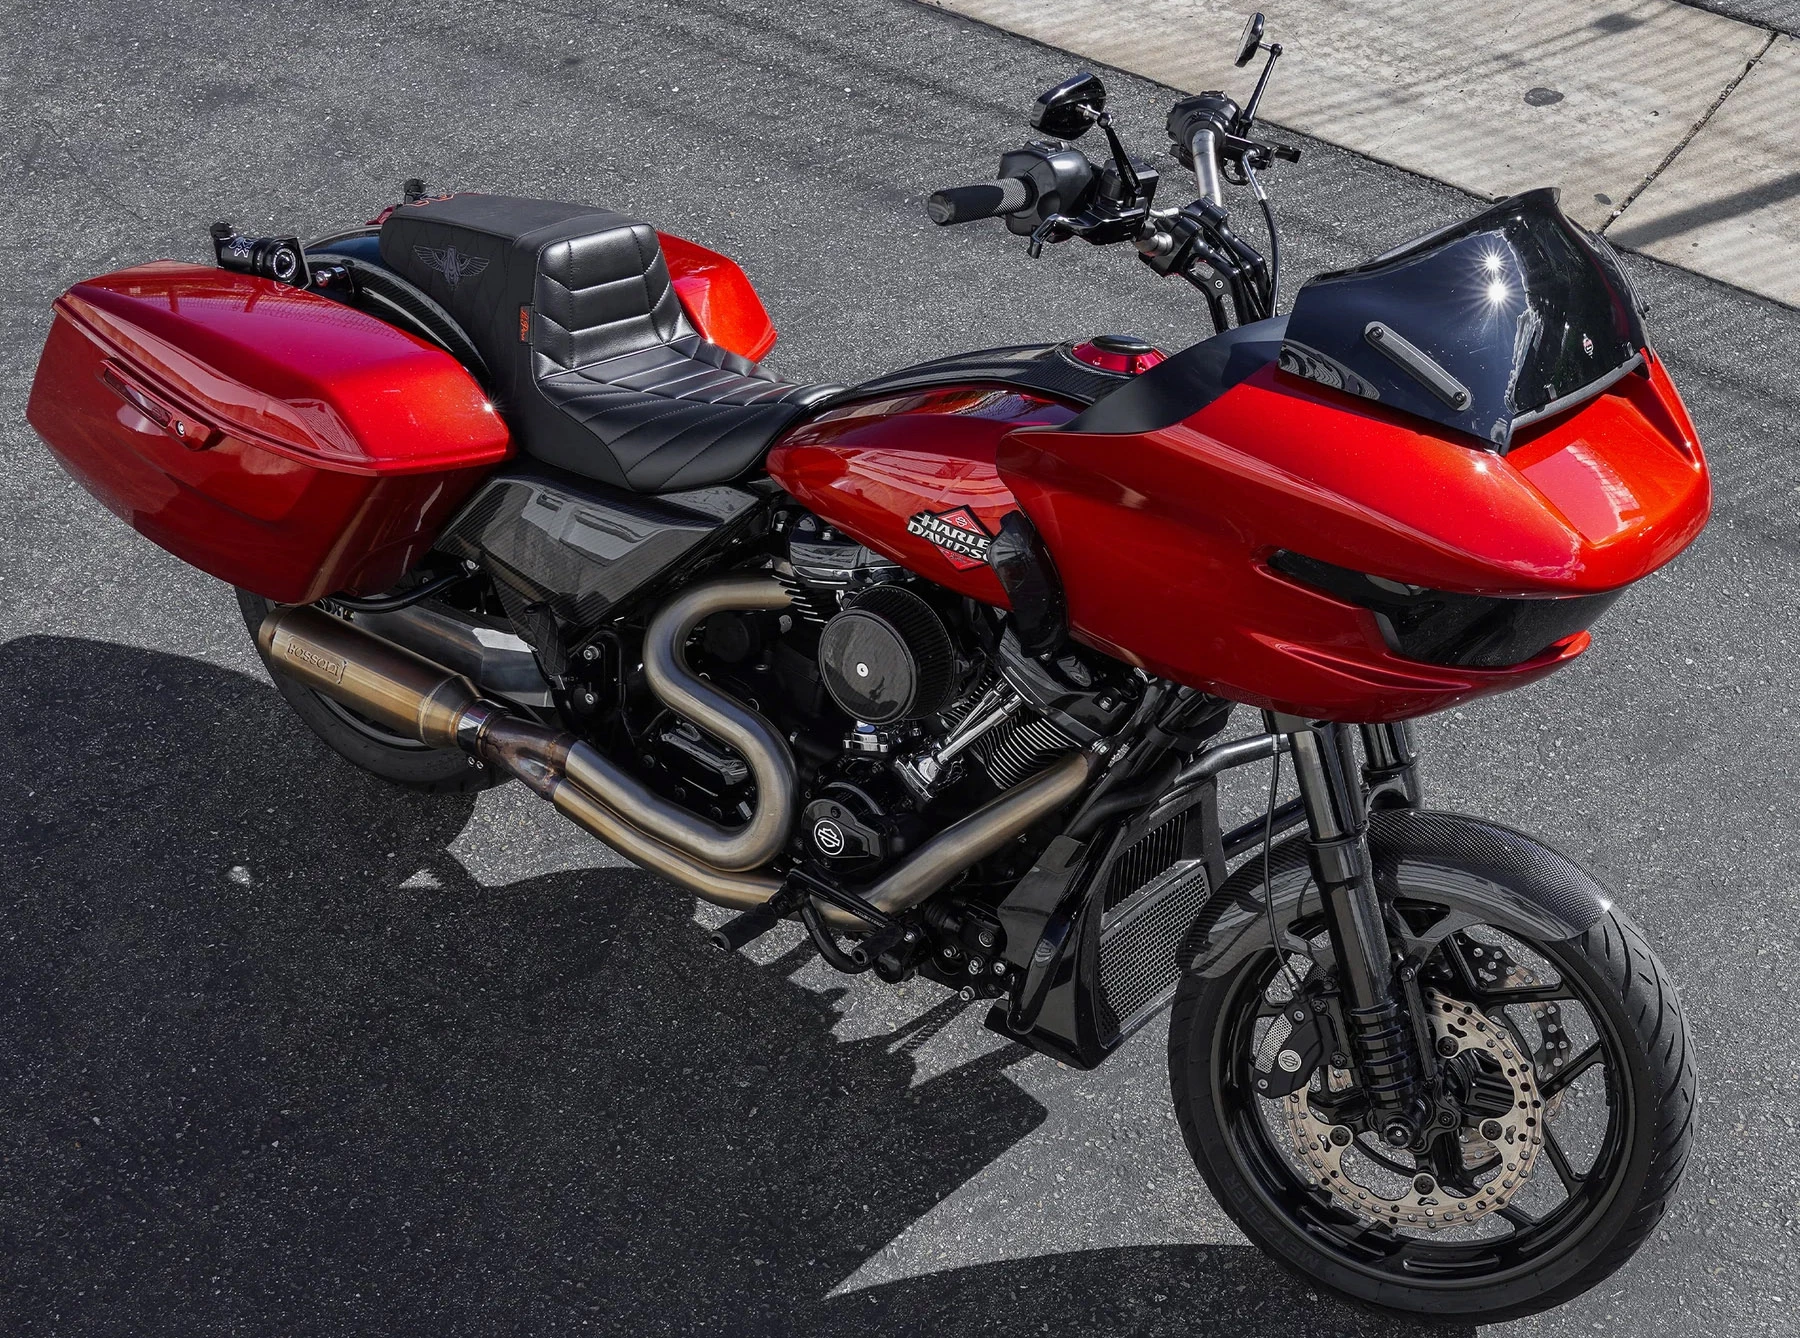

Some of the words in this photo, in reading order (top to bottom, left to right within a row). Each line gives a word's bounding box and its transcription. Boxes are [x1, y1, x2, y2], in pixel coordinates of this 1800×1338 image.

[907, 521, 989, 562] DAVIDS
[915, 514, 991, 550] HARLE
[1223, 1173, 1320, 1270] METZELER
